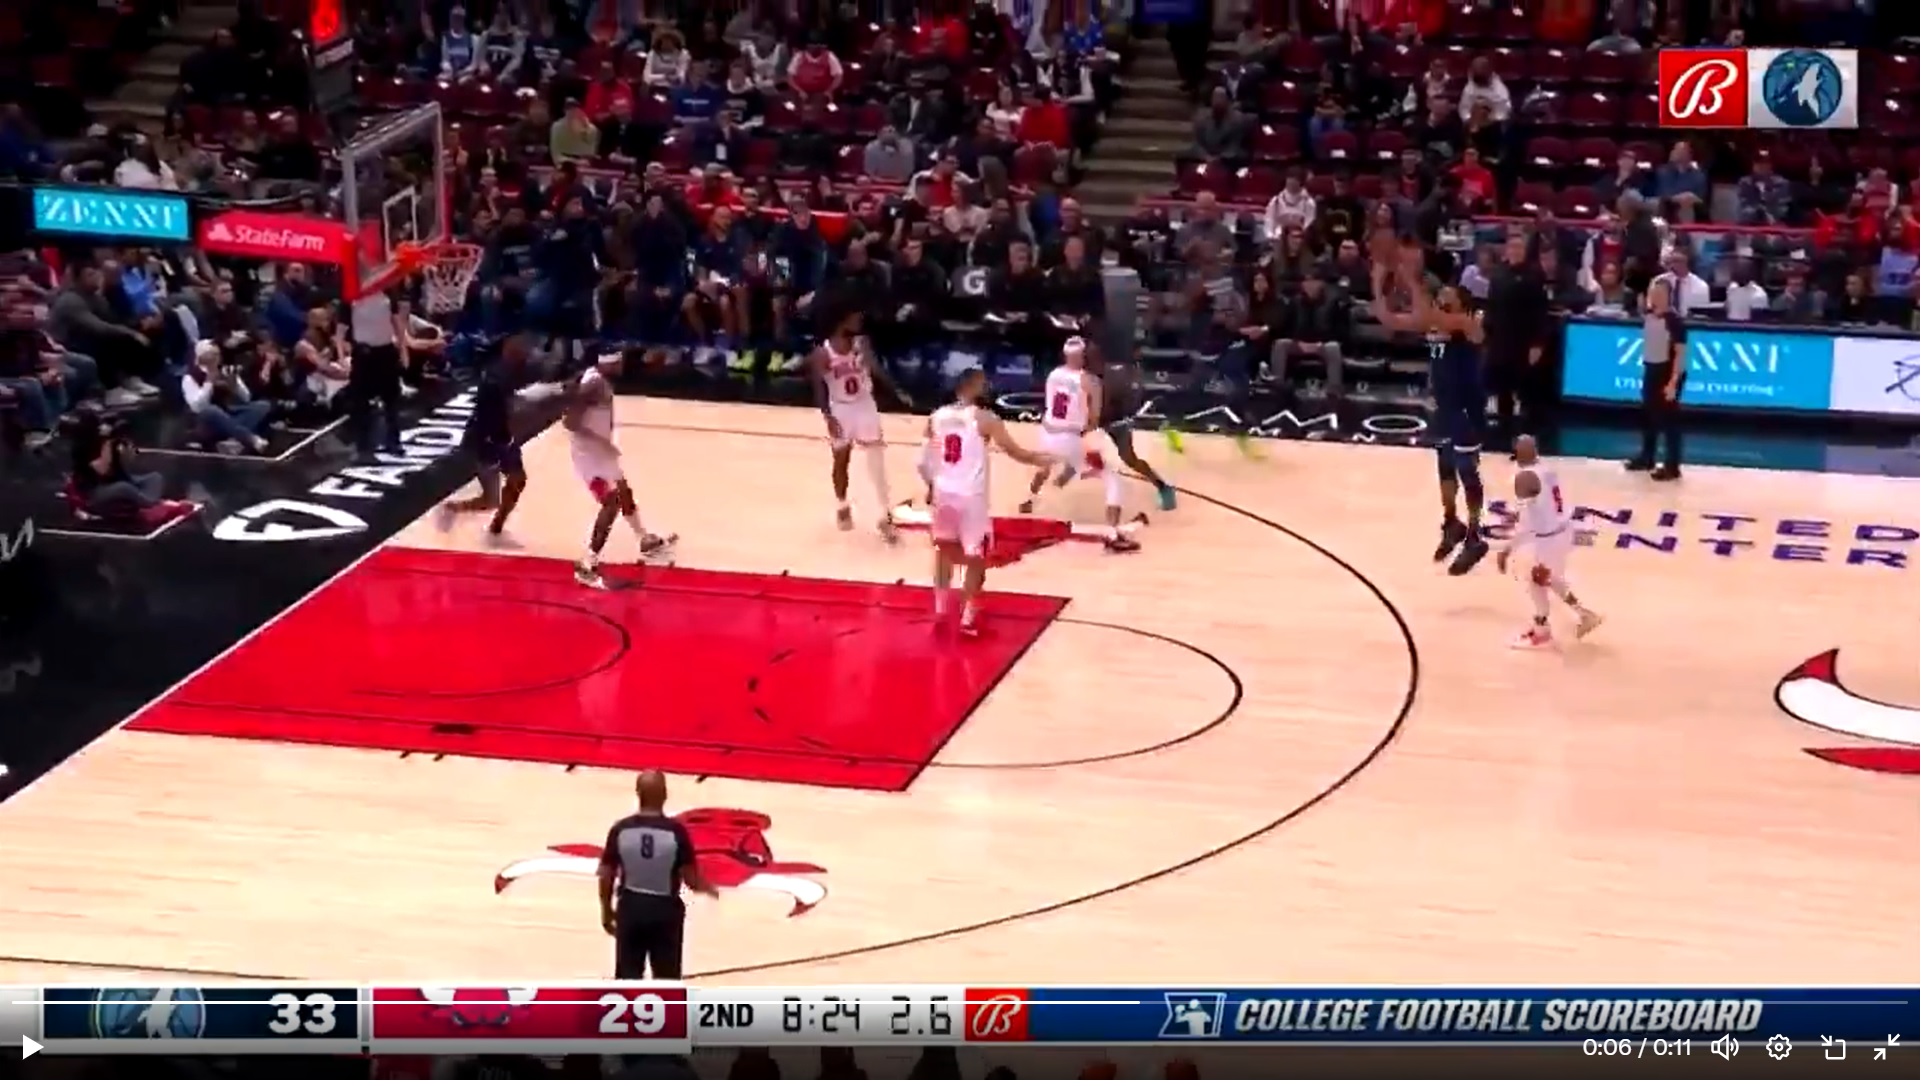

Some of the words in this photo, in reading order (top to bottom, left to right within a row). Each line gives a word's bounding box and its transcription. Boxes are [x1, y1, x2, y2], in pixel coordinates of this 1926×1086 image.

[43, 195, 172, 231] ZENNI
[962, 269, 987, 296] G
[1616, 337, 1779, 374] ZNNI
[640, 832, 655, 860] 8
